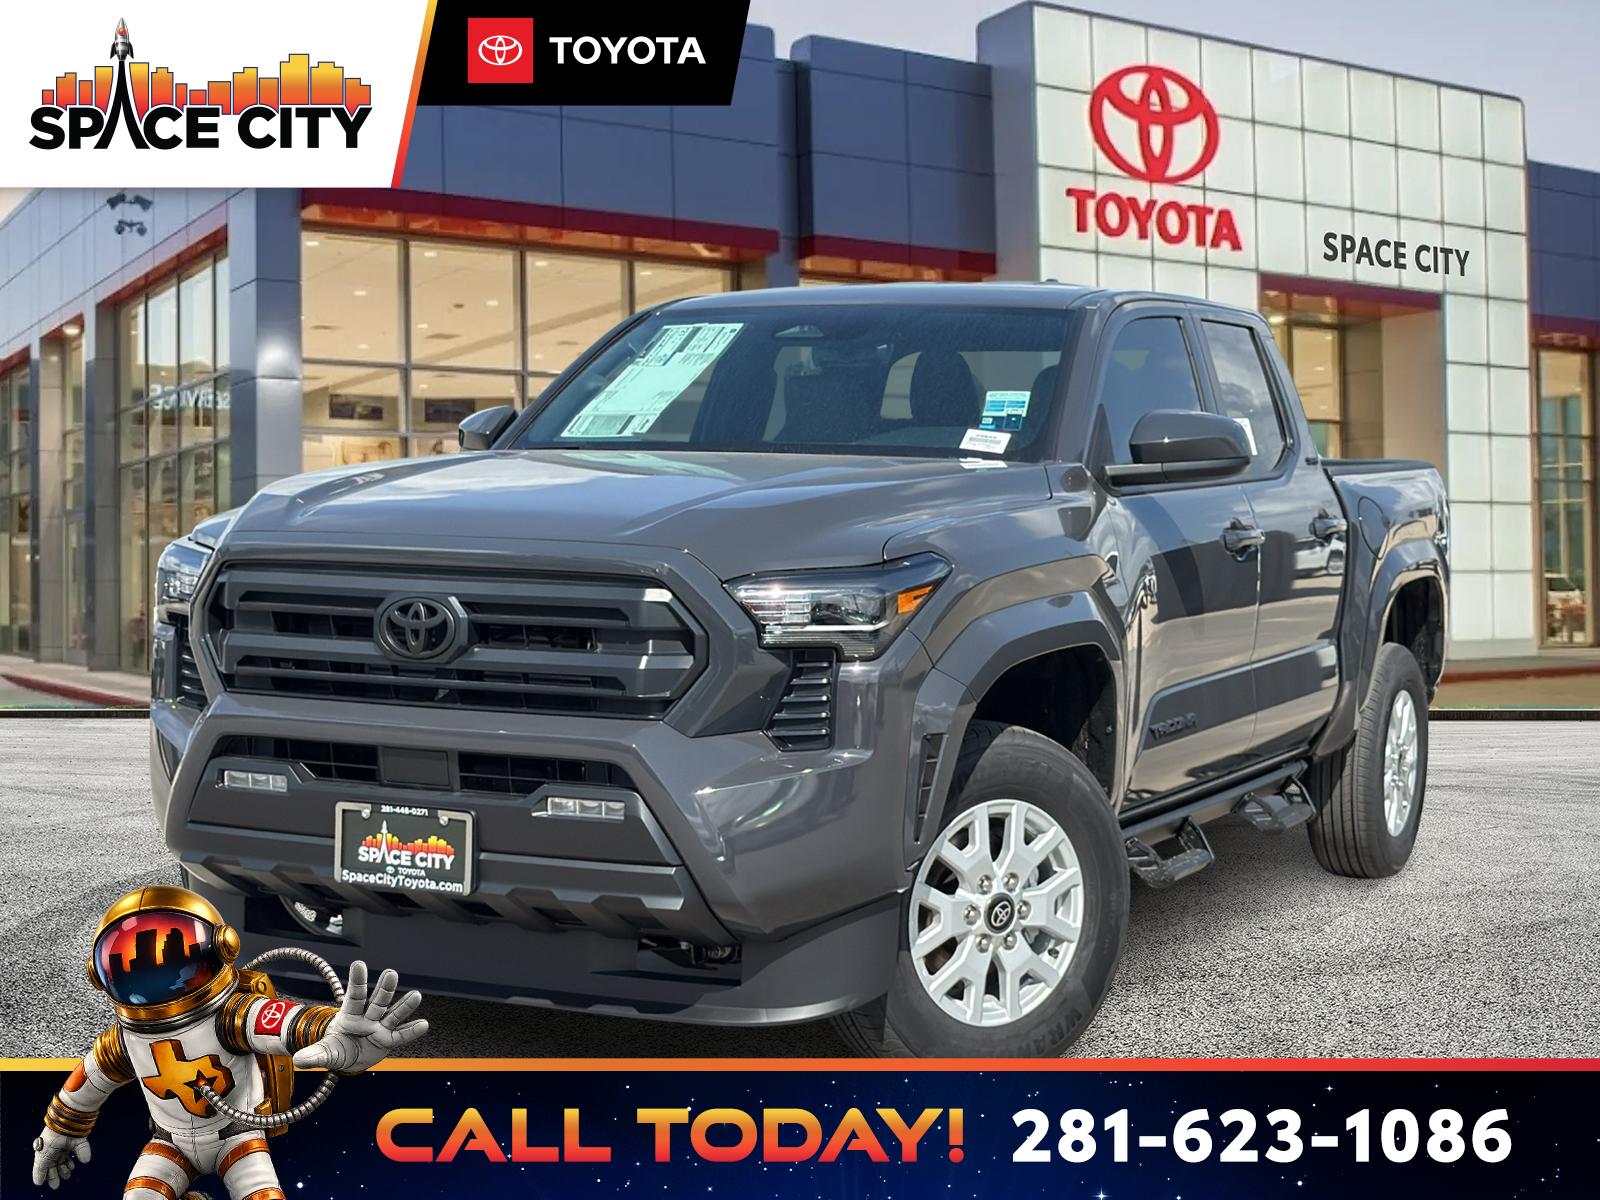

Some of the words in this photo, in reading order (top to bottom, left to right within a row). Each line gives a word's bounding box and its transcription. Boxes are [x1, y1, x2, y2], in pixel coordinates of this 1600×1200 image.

[1066, 188, 1242, 251] TOYOTA
[1322, 231, 1407, 270] SPACE
[1414, 244, 1470, 277] CITY
[358, 844, 412, 867] SPACE
[415, 851, 455, 870] CITY
[341, 869, 463, 893] SpaceCityToyota.com
[398, 866, 426, 877] TOYOTA
